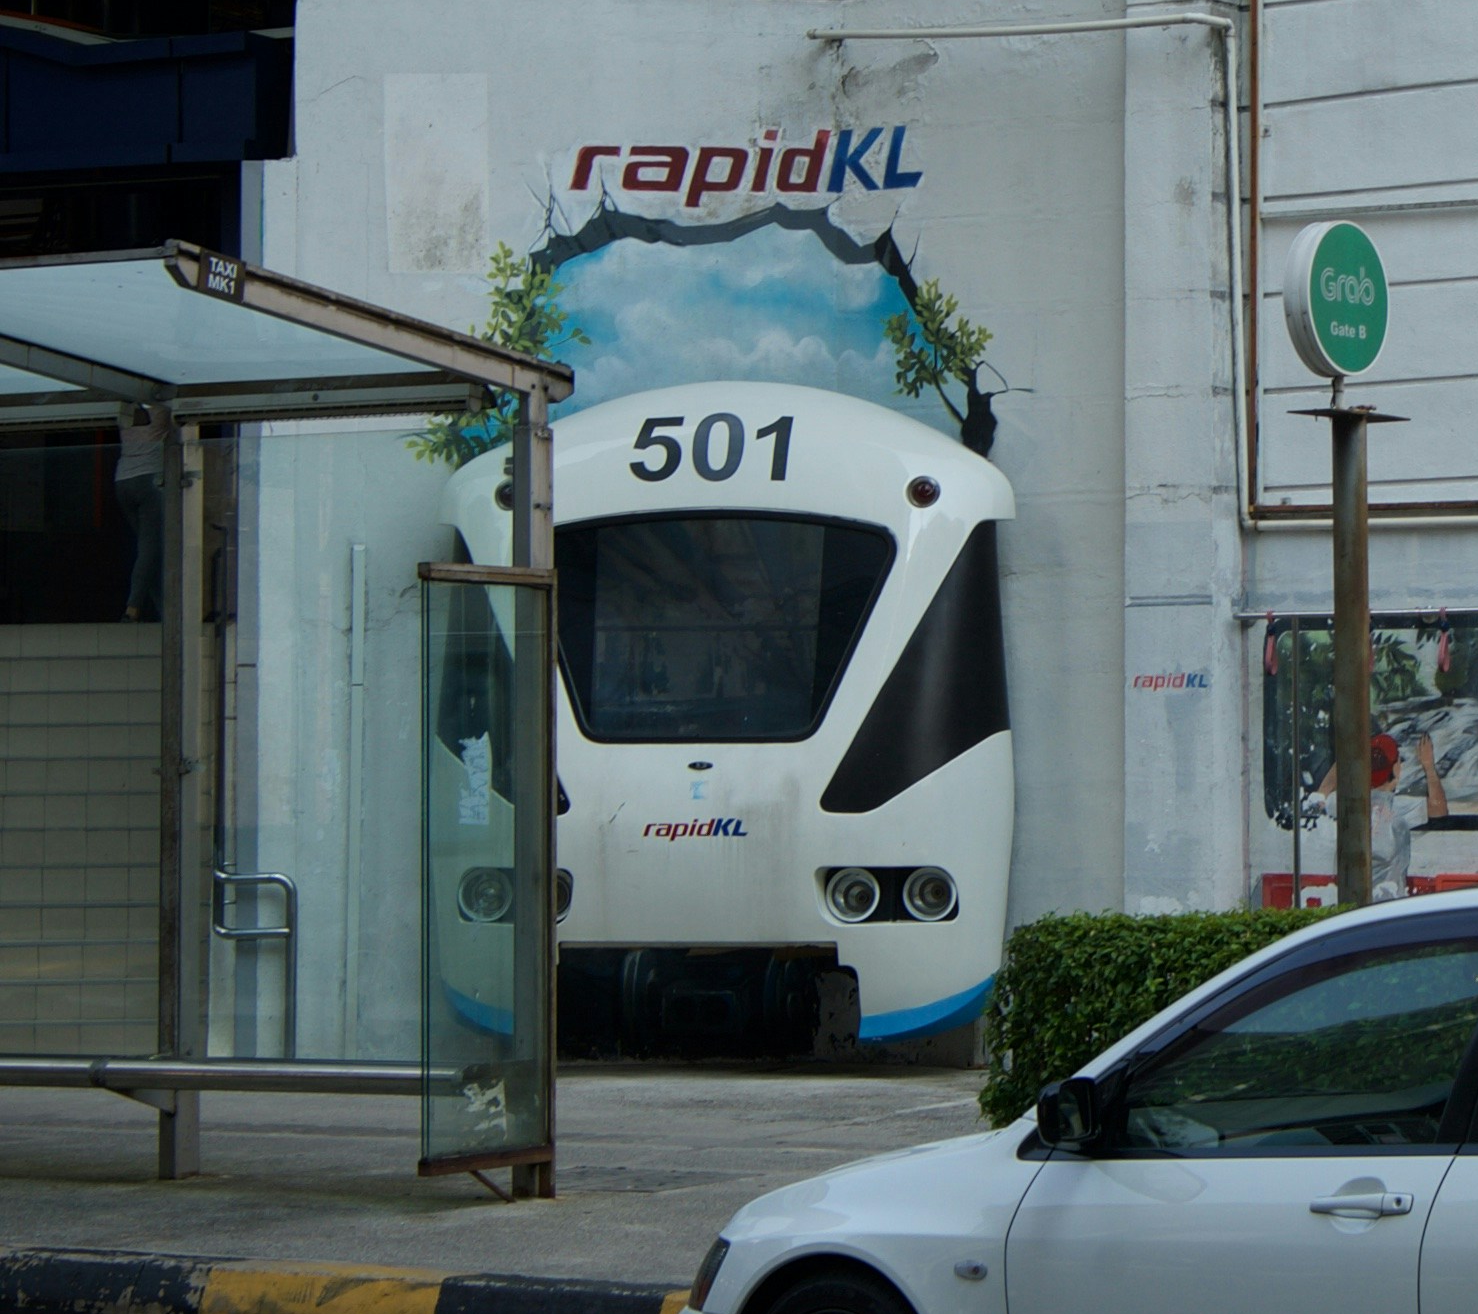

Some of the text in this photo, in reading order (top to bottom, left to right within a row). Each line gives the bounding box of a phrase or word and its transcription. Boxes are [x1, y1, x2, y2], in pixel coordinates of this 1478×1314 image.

[570, 125, 923, 208] rapidKL
[209, 256, 238, 279] TAXI
[207, 273, 236, 296] MK1
[1320, 265, 1376, 307] Grab
[1330, 321, 1368, 340] Gate B
[629, 412, 795, 482] 501
[1133, 671, 1208, 692] rapidKL
[643, 818, 749, 842] rapidKL
